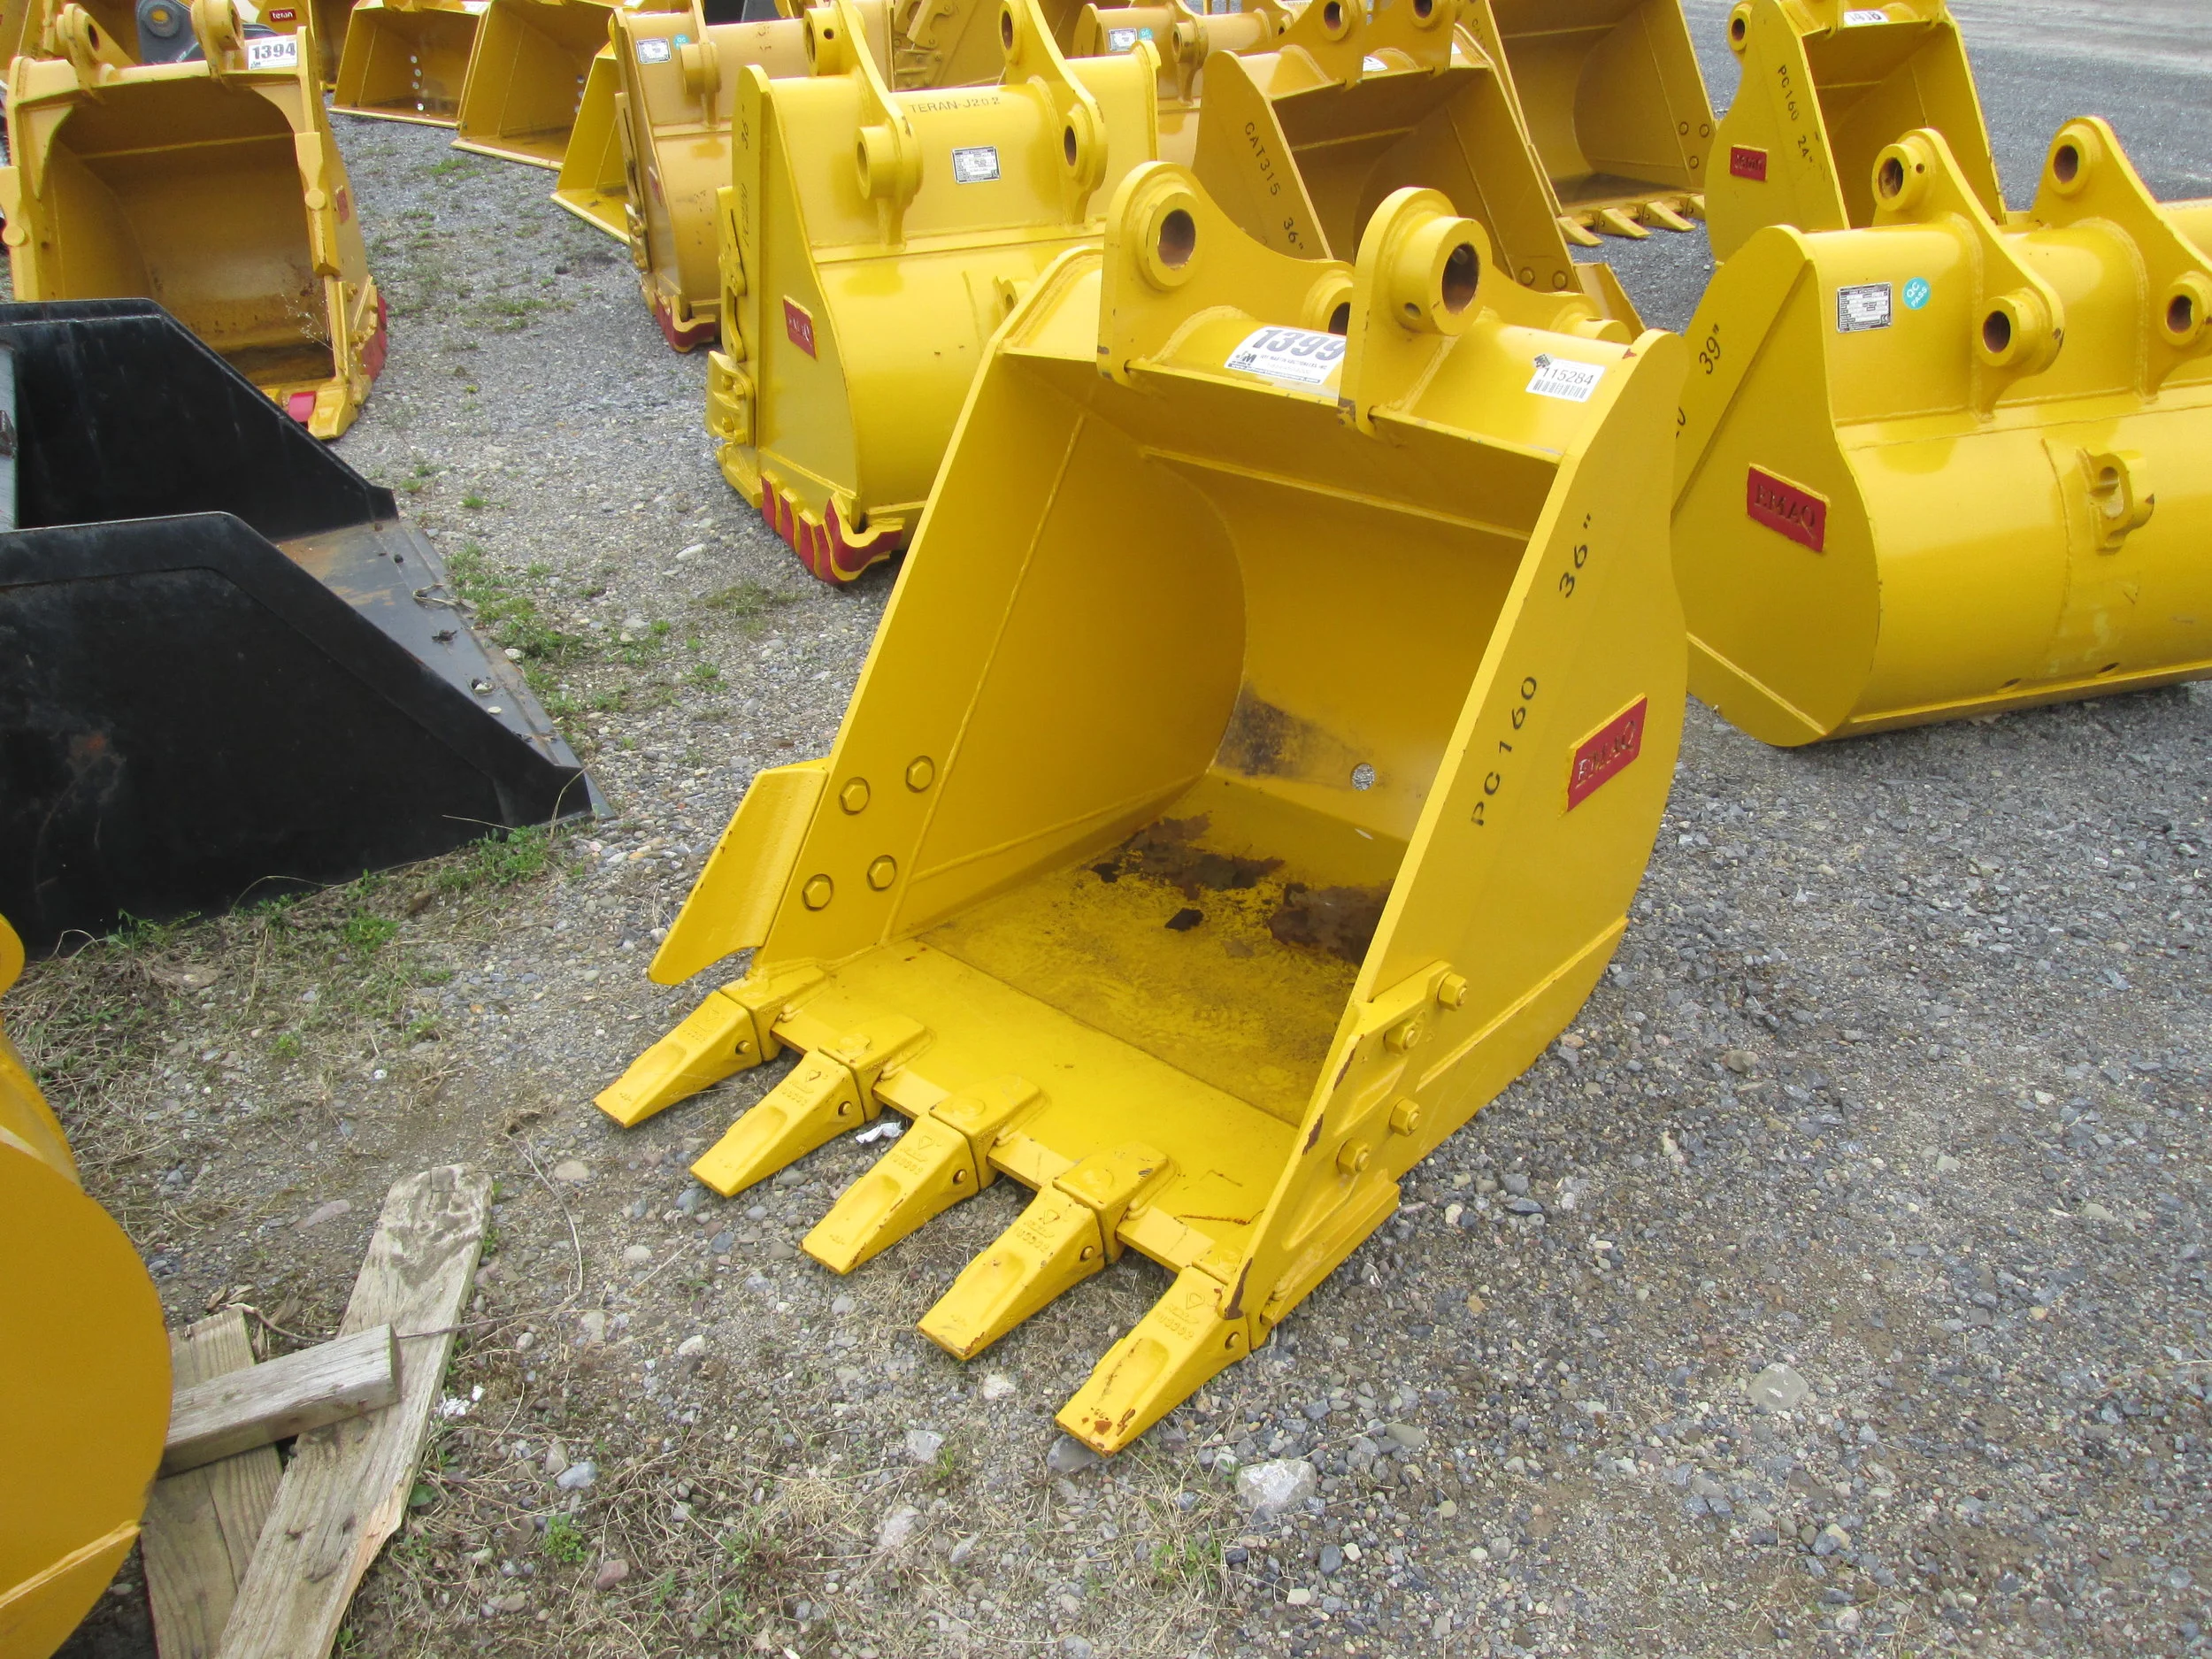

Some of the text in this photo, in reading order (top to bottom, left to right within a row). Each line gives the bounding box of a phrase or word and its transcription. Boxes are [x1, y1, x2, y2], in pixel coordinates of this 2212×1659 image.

[272, 11, 293, 19] teran
[252, 42, 296, 60] 1394
[1778, 64, 1800, 121] PC160
[1244, 121, 1305, 250] CAT315 36"
[1906, 281, 1920, 298] QC
[1910, 286, 1928, 308] PASS
[1252, 328, 1346, 361] 1399
[1699, 323, 1720, 375] 39"
[1542, 366, 1594, 385] 115284
[1755, 484, 1816, 539] EMAQ
[1471, 512, 1593, 827] PC160 36"
